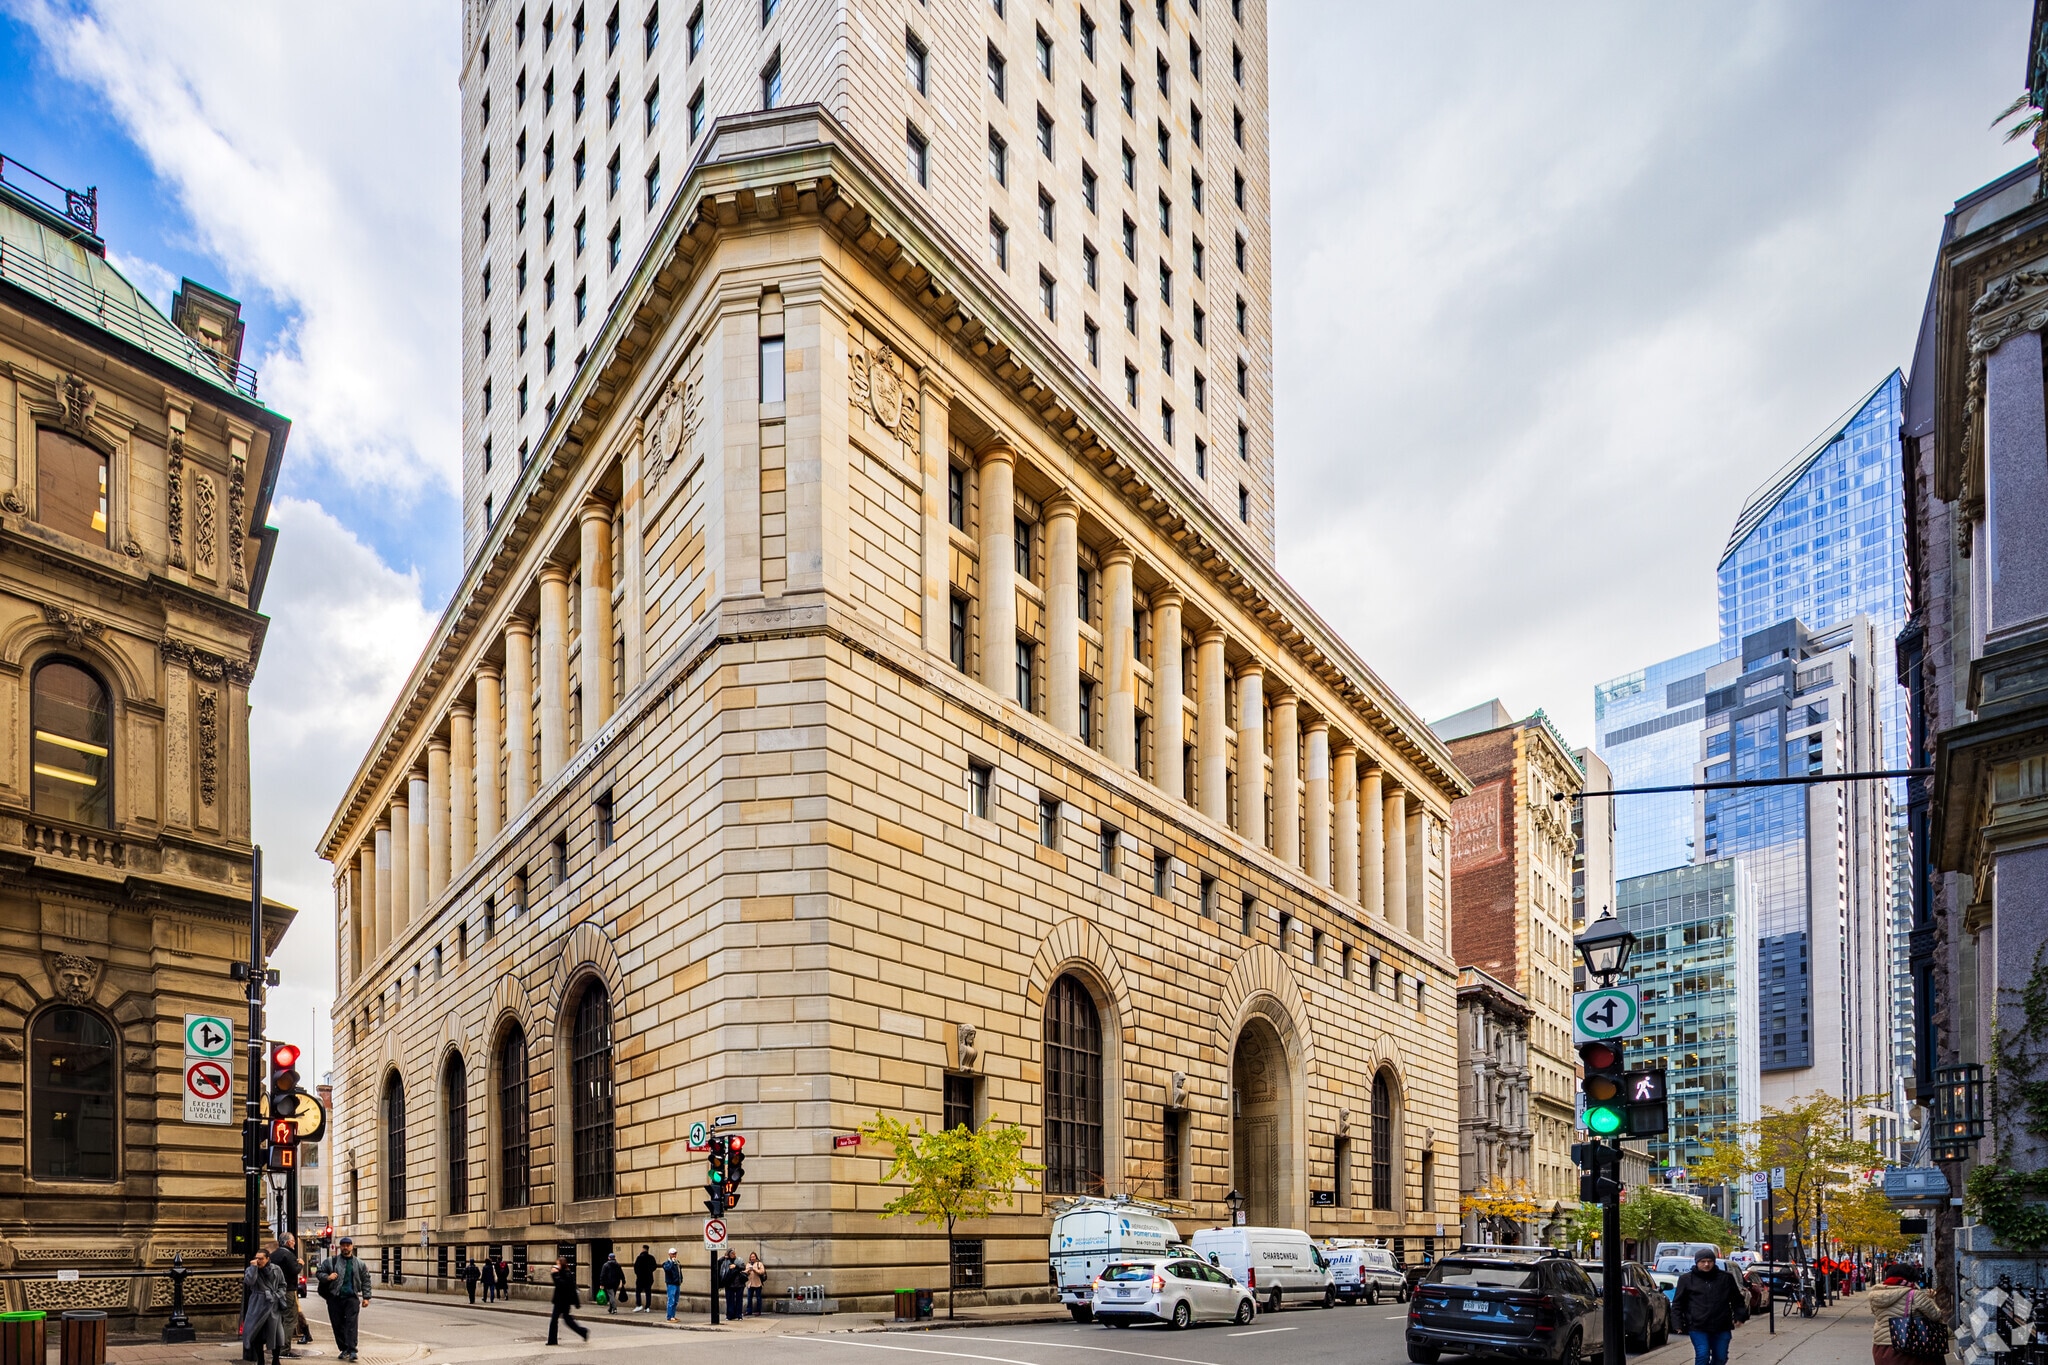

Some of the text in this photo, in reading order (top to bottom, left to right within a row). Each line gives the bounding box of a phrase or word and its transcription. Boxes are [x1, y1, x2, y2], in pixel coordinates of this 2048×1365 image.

[189, 1106, 227, 1114] LIVRAISON
[194, 1112, 221, 1120] LOCALE
[1262, 1251, 1299, 1260] CHARBONNEAU
[1329, 1254, 1353, 1265] rphil
